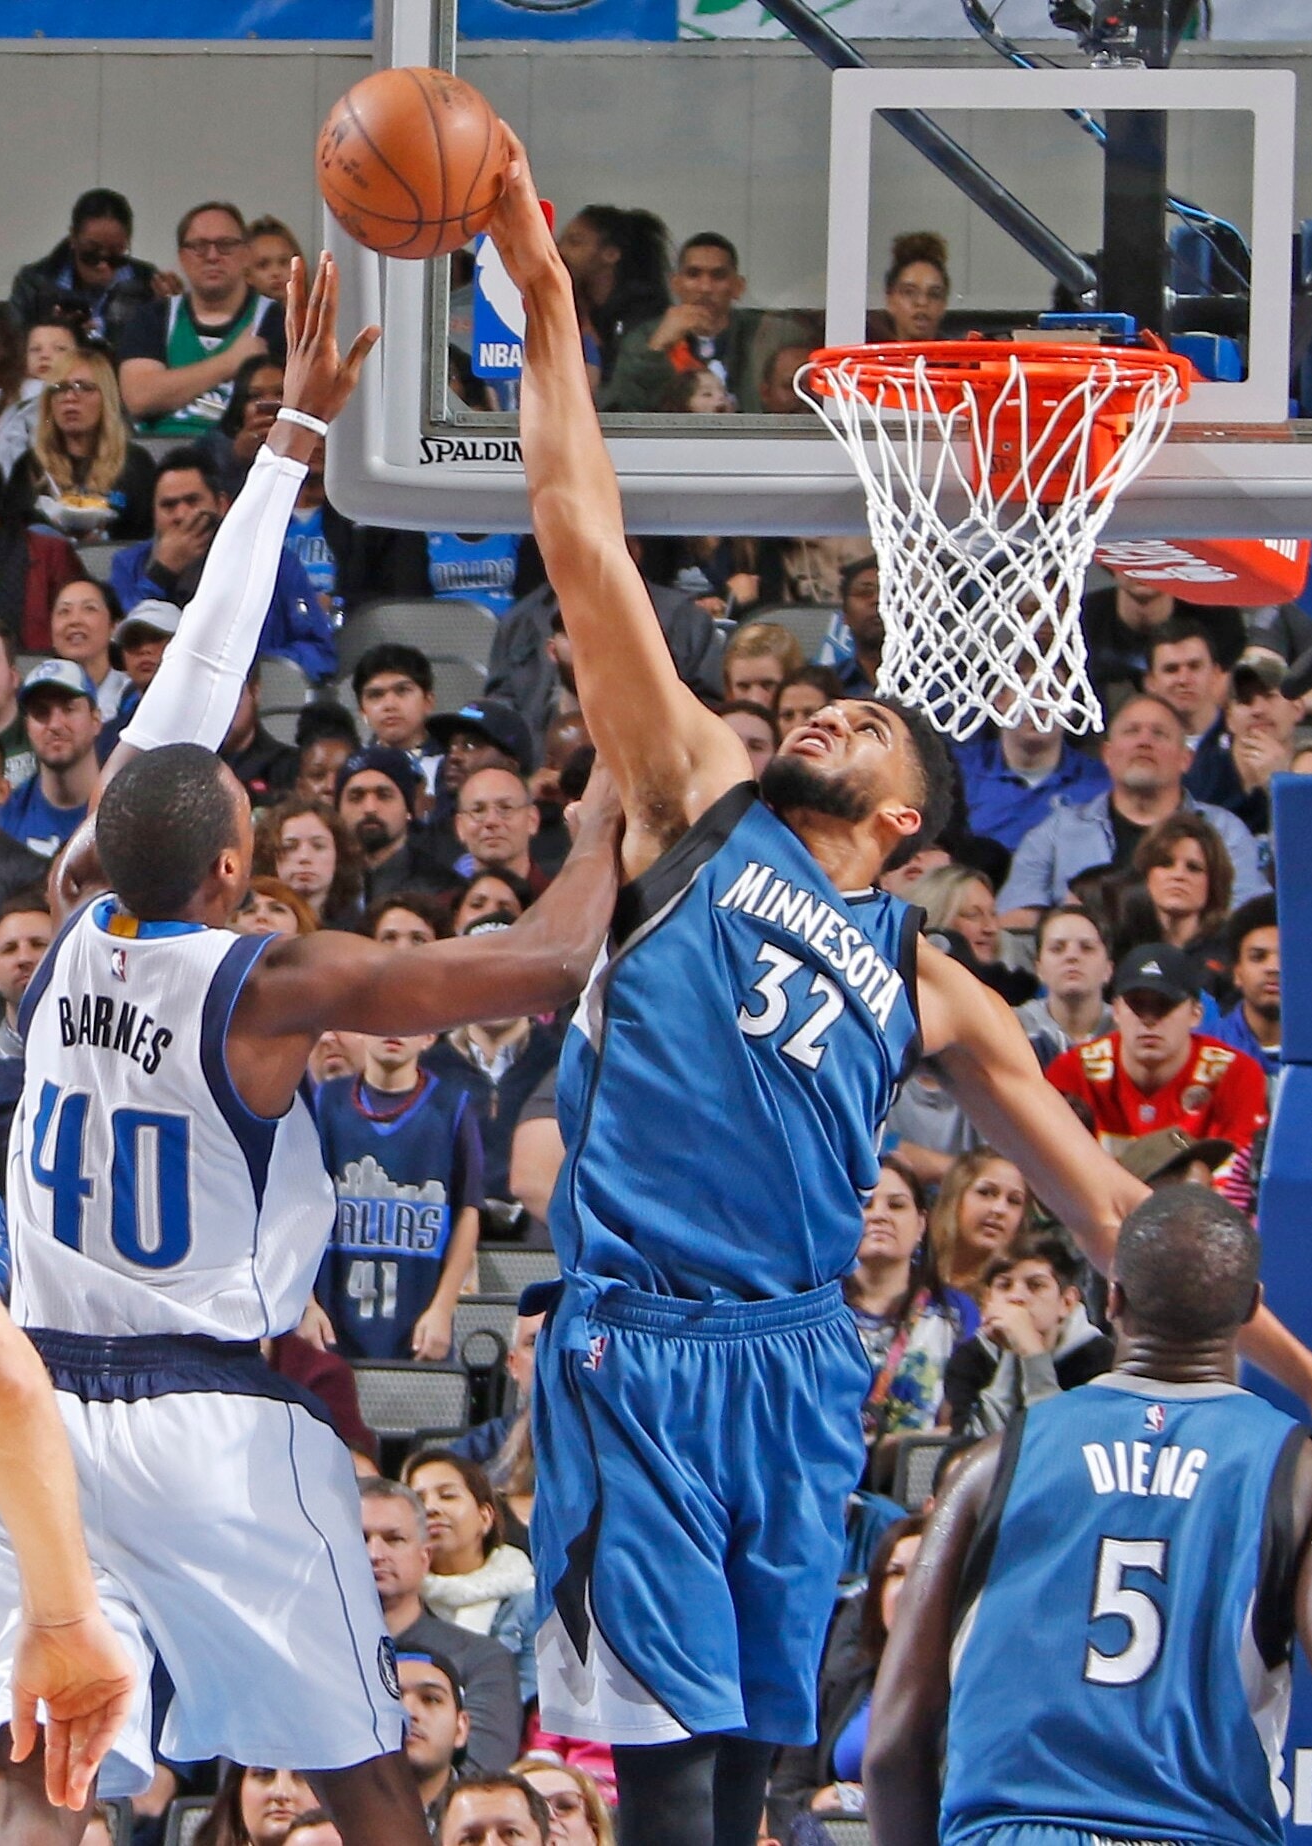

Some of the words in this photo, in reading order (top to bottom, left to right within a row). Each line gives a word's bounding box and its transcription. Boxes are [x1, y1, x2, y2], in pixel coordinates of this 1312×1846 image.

[480, 343, 523, 367] NBA
[420, 437, 524, 464] SPALDIN
[717, 862, 905, 1032] MINNESOTA
[59, 994, 173, 1075] BARNES
[738, 942, 846, 1070] 32
[31, 1078, 192, 1270] 40
[330, 1200, 443, 1251] ALLAS
[347, 1261, 398, 1318] 41
[1082, 1441, 1208, 1500] DIENG
[1082, 1535, 1169, 1688] 5
